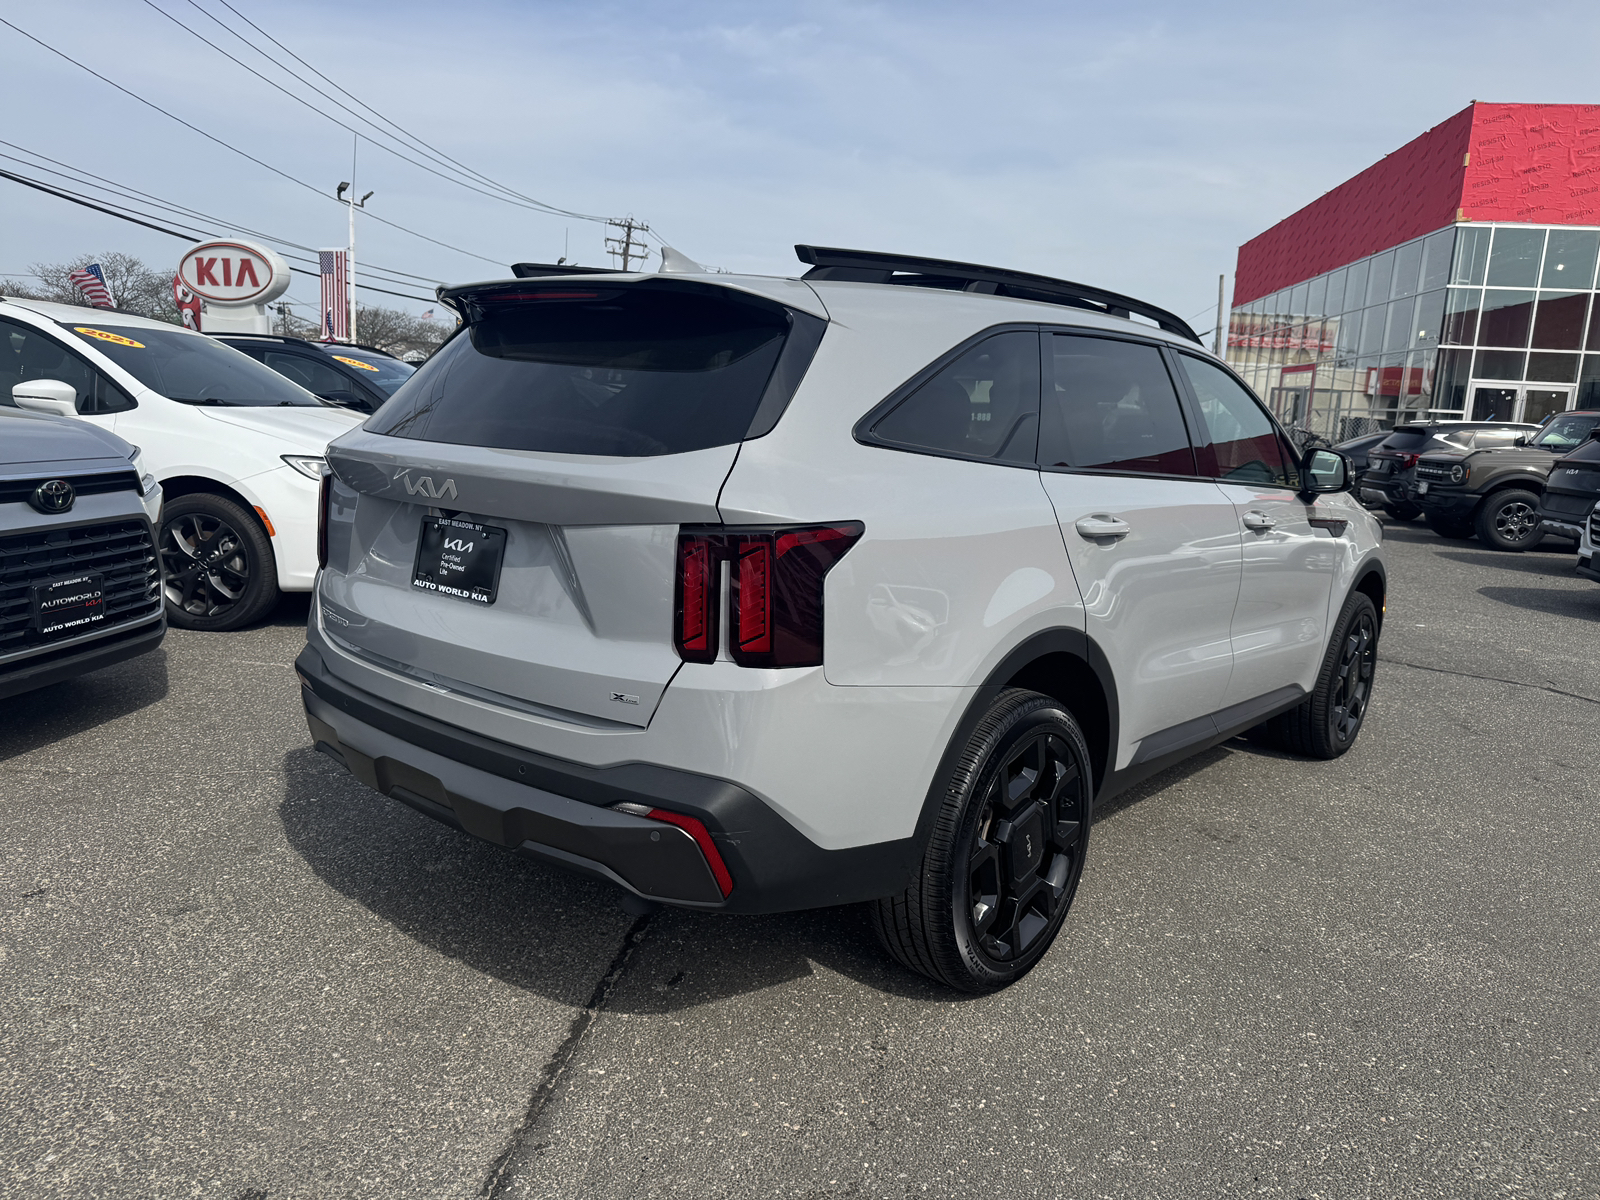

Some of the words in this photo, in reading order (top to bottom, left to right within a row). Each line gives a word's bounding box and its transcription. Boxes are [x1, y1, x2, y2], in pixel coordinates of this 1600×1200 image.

[195, 257, 260, 287] KIA
[403, 474, 459, 500] KIA
[438, 518, 451, 526] EAST
[443, 537, 474, 553] KIA
[441, 552, 462, 563] Certified
[440, 561, 466, 572] Pre-Owned
[413, 579, 437, 590] AUTO
[438, 584, 469, 598] WORLD
[471, 592, 488, 603] KIA
[41, 591, 101, 609] AUTOWORLD
[85, 598, 102, 607] KIA
[43, 624, 63, 634] AUTO
[64, 617, 90, 628] WORLD
[91, 614, 104, 622] KIA
